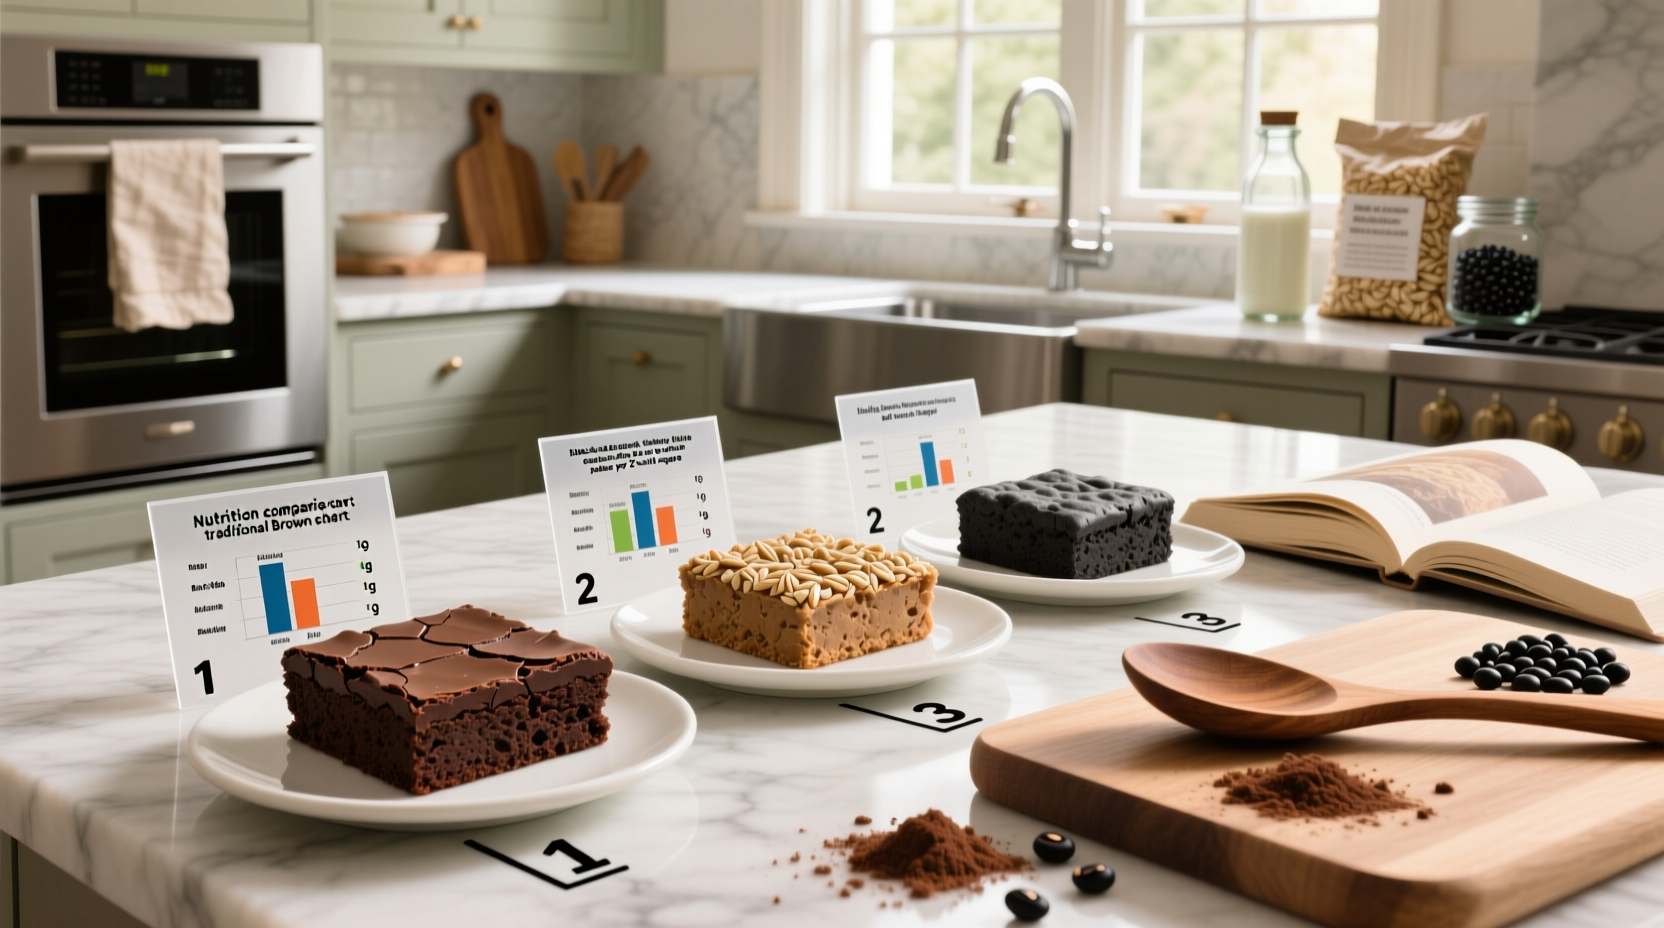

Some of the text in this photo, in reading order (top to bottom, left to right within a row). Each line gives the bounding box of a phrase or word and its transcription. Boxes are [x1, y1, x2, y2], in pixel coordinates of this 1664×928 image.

[193, 509, 259, 528] Nutrition
[271, 517, 313, 532] Brown
[866, 507, 885, 534] 2
[575, 572, 599, 606] 2
[193, 659, 215, 695] 1
[913, 703, 966, 724] 3
[542, 838, 611, 875] 1
